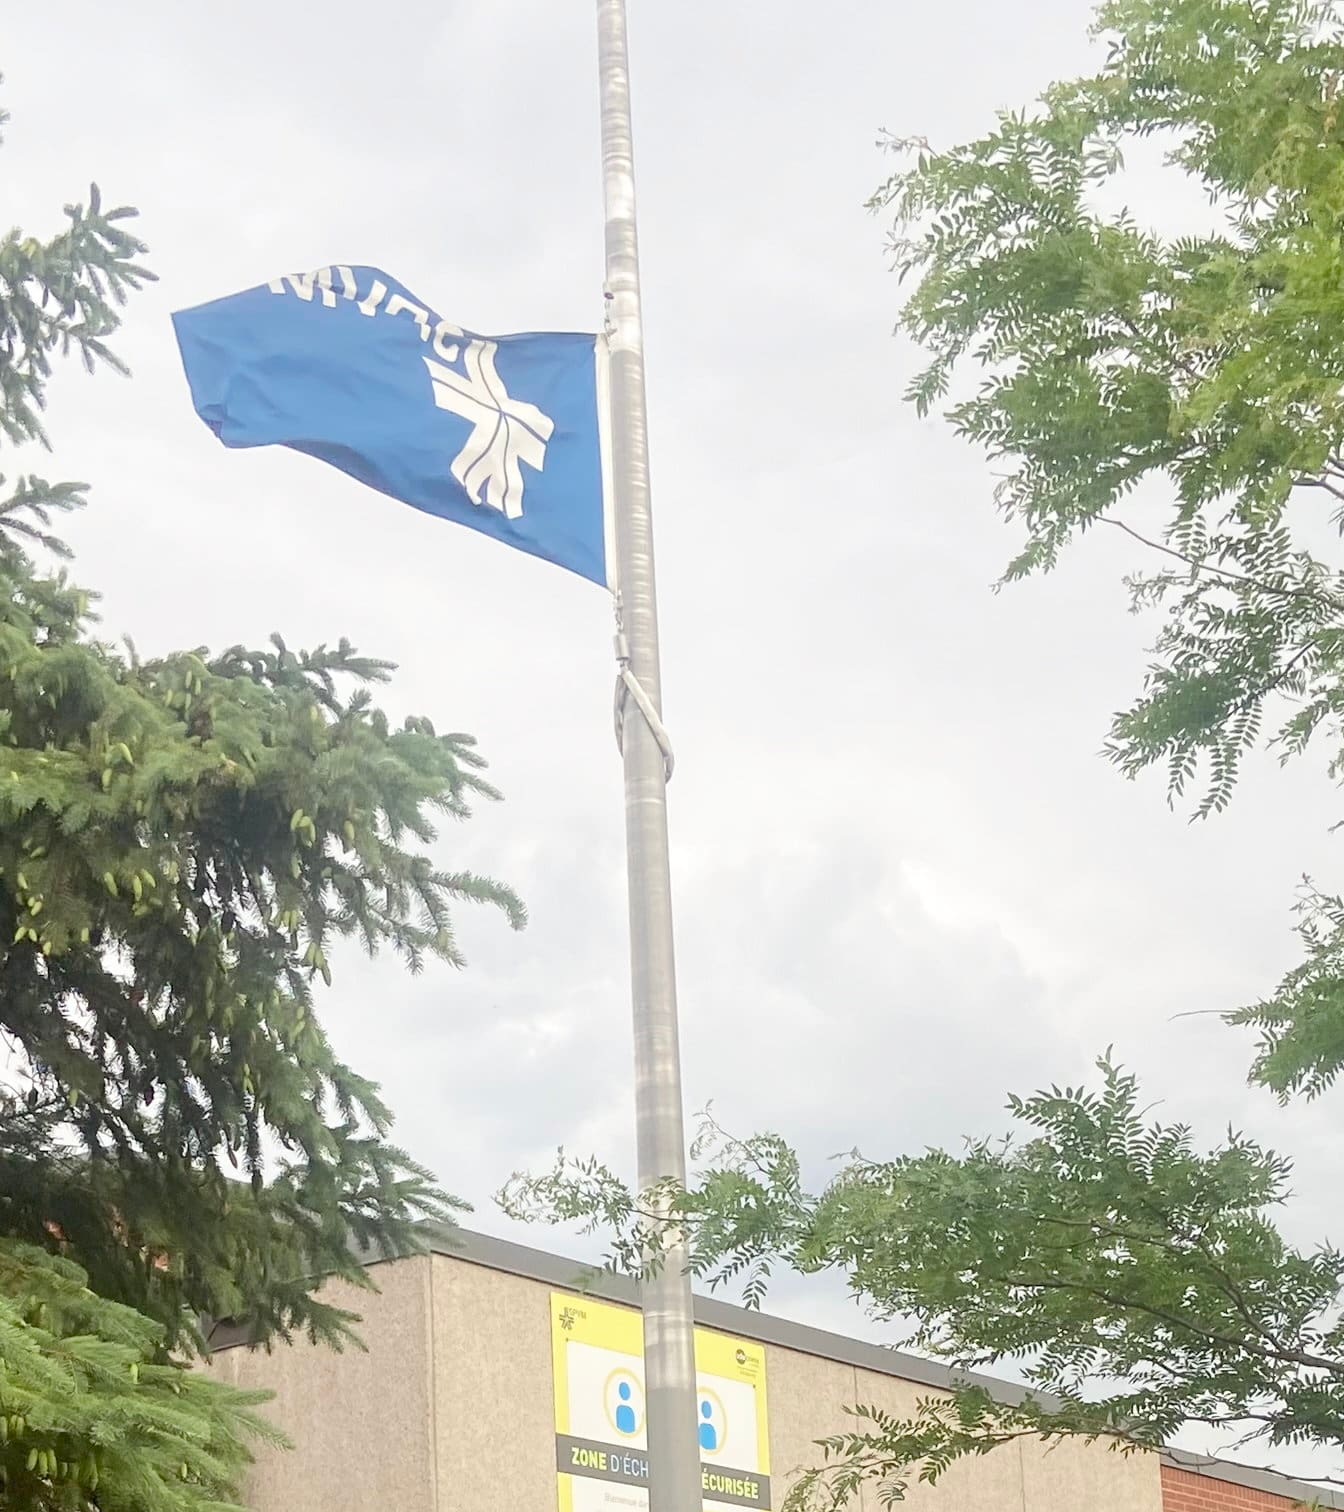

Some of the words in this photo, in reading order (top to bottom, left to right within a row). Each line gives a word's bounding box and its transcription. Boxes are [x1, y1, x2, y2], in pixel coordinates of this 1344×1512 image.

[571, 1447, 607, 1471] ZONE
[611, 1452, 649, 1478] D'ÉCH
[702, 1468, 759, 1500] ÉCURISÉE
